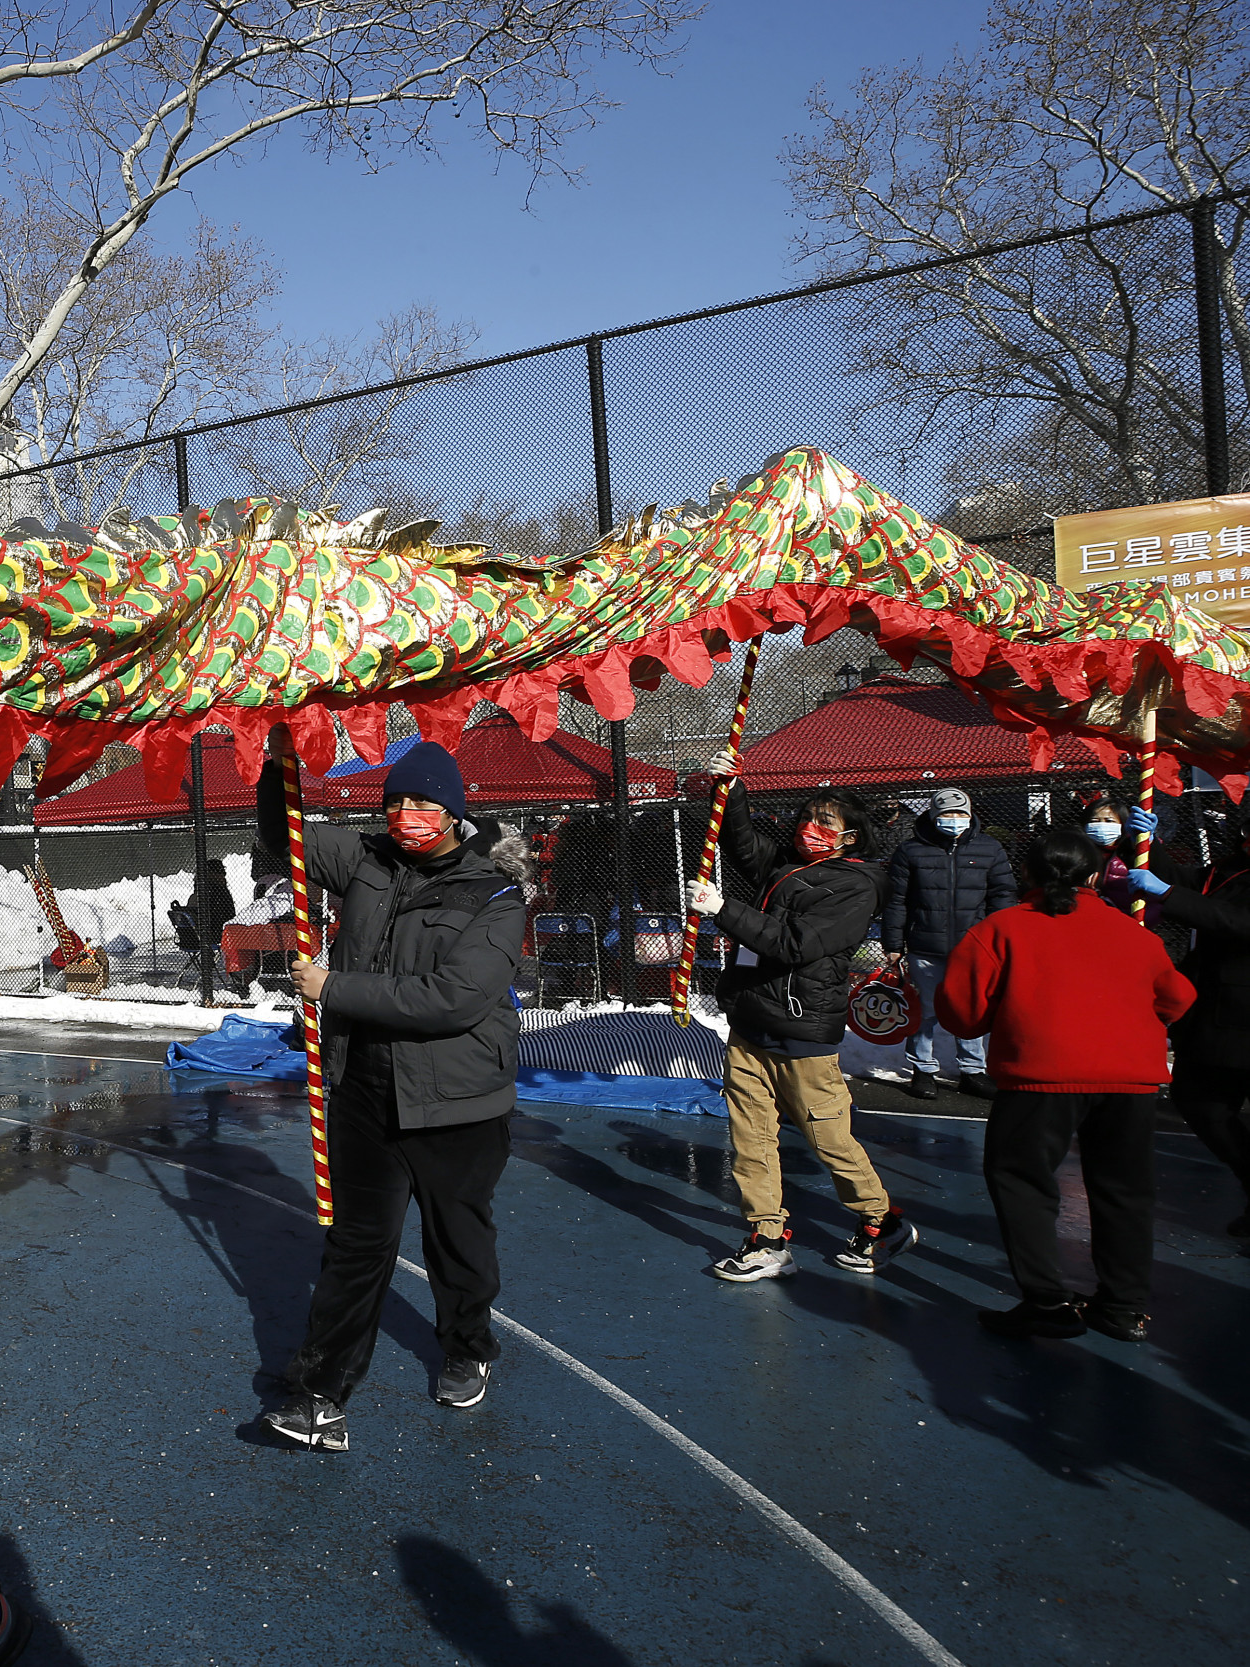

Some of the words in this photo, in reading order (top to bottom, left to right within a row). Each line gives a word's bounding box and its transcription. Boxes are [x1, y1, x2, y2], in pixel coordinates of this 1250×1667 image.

[1079, 525, 1250, 574] 巨星雲集
[1184, 586, 1250, 605] MOHE
